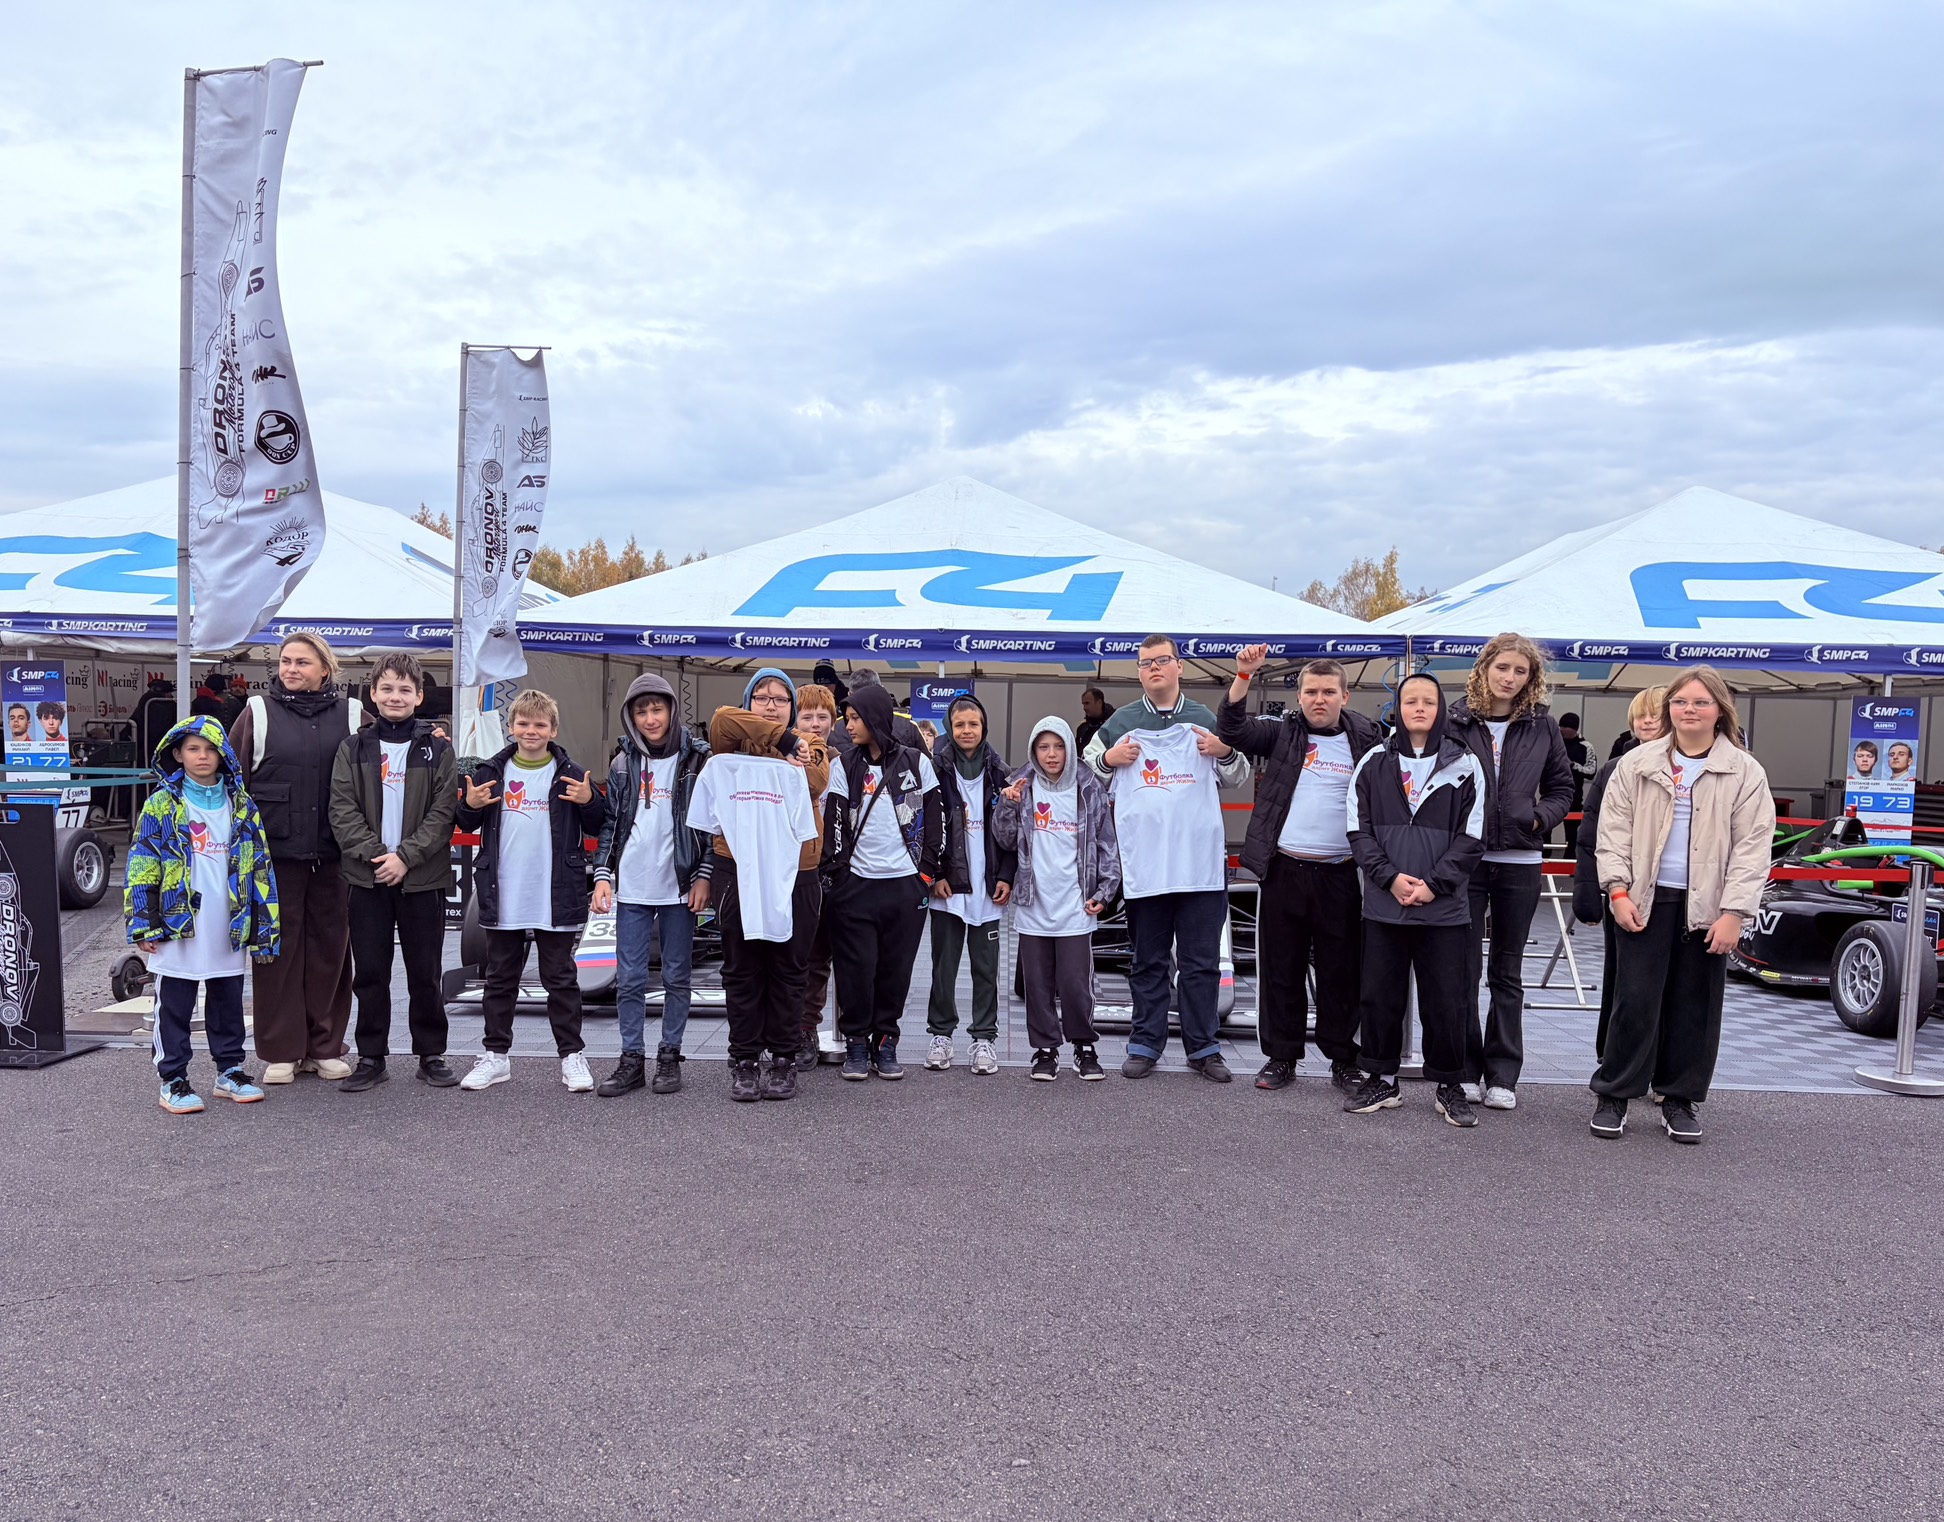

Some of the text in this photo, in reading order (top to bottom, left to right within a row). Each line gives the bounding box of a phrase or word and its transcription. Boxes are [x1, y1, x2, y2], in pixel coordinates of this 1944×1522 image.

[230, 313, 238, 357] TEAM
[213, 356, 231, 456] DRON
[237, 375, 247, 453] FORMULA
[266, 442, 296, 459] DON CUP
[483, 486, 496, 574] DRONOV
[265, 531, 309, 547] КОДОР
[499, 528, 508, 573] FORMULA
[61, 620, 148, 632] SMPKARTING
[519, 630, 604, 642] SMPKARTING
[745, 636, 831, 648] SMPKARTING
[970, 639, 1056, 651] SMPKARTING
[1104, 641, 1141, 652] SMPF
[1197, 642, 1286, 654] SMPKANG
[1680, 646, 1771, 659] SMPKARTING
[12, 756, 32, 767] 21
[39, 756, 67, 768] 77
[1313, 759, 1353, 771] Футболка
[1160, 773, 1194, 781] Футболка
[1331, 768, 1354, 776] Жизн
[1852, 795, 1874, 808] 19
[1882, 796, 1911, 809] 73
[62, 810, 80, 828] 77
[2, 903, 19, 1001] DRONOV
